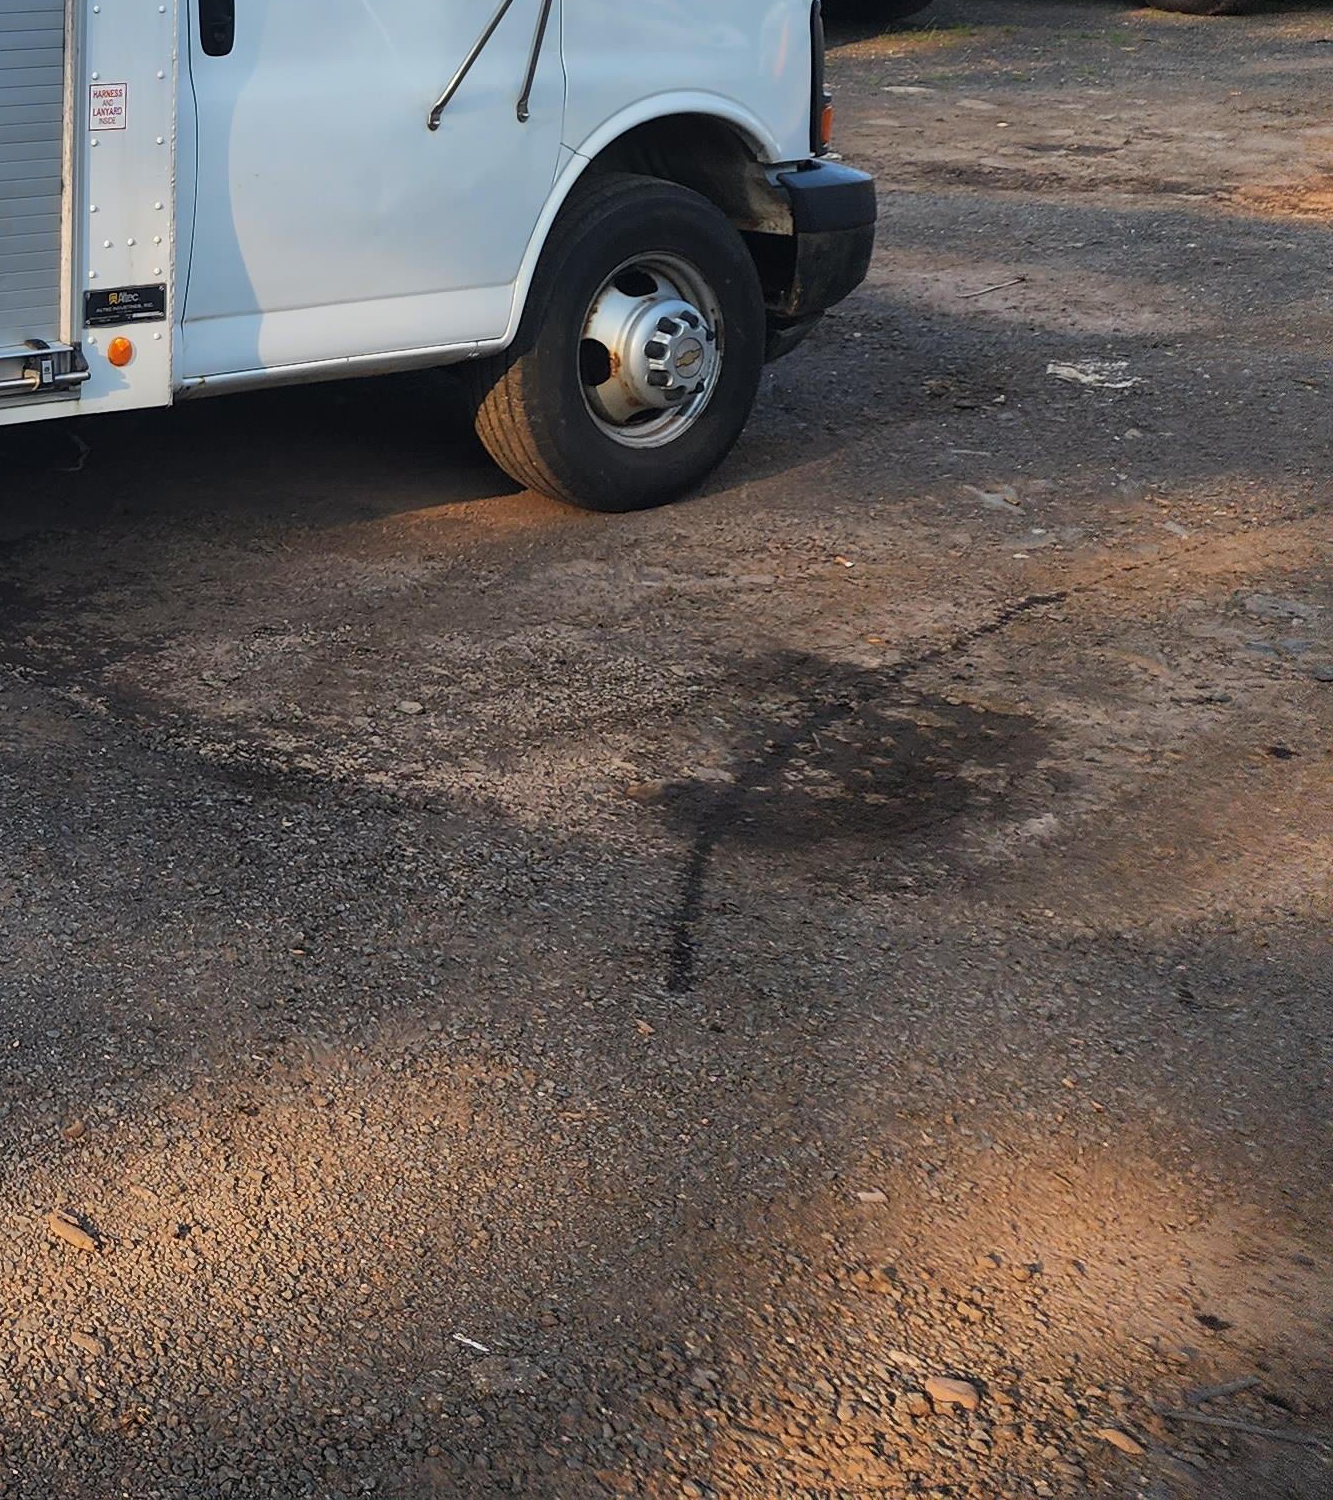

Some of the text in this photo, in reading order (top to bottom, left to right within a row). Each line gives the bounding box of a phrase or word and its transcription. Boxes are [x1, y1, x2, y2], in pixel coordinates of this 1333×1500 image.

[93, 89, 123, 98] HARNESS
[93, 107, 123, 116] LANYARD
[118, 291, 139, 303] Altec
